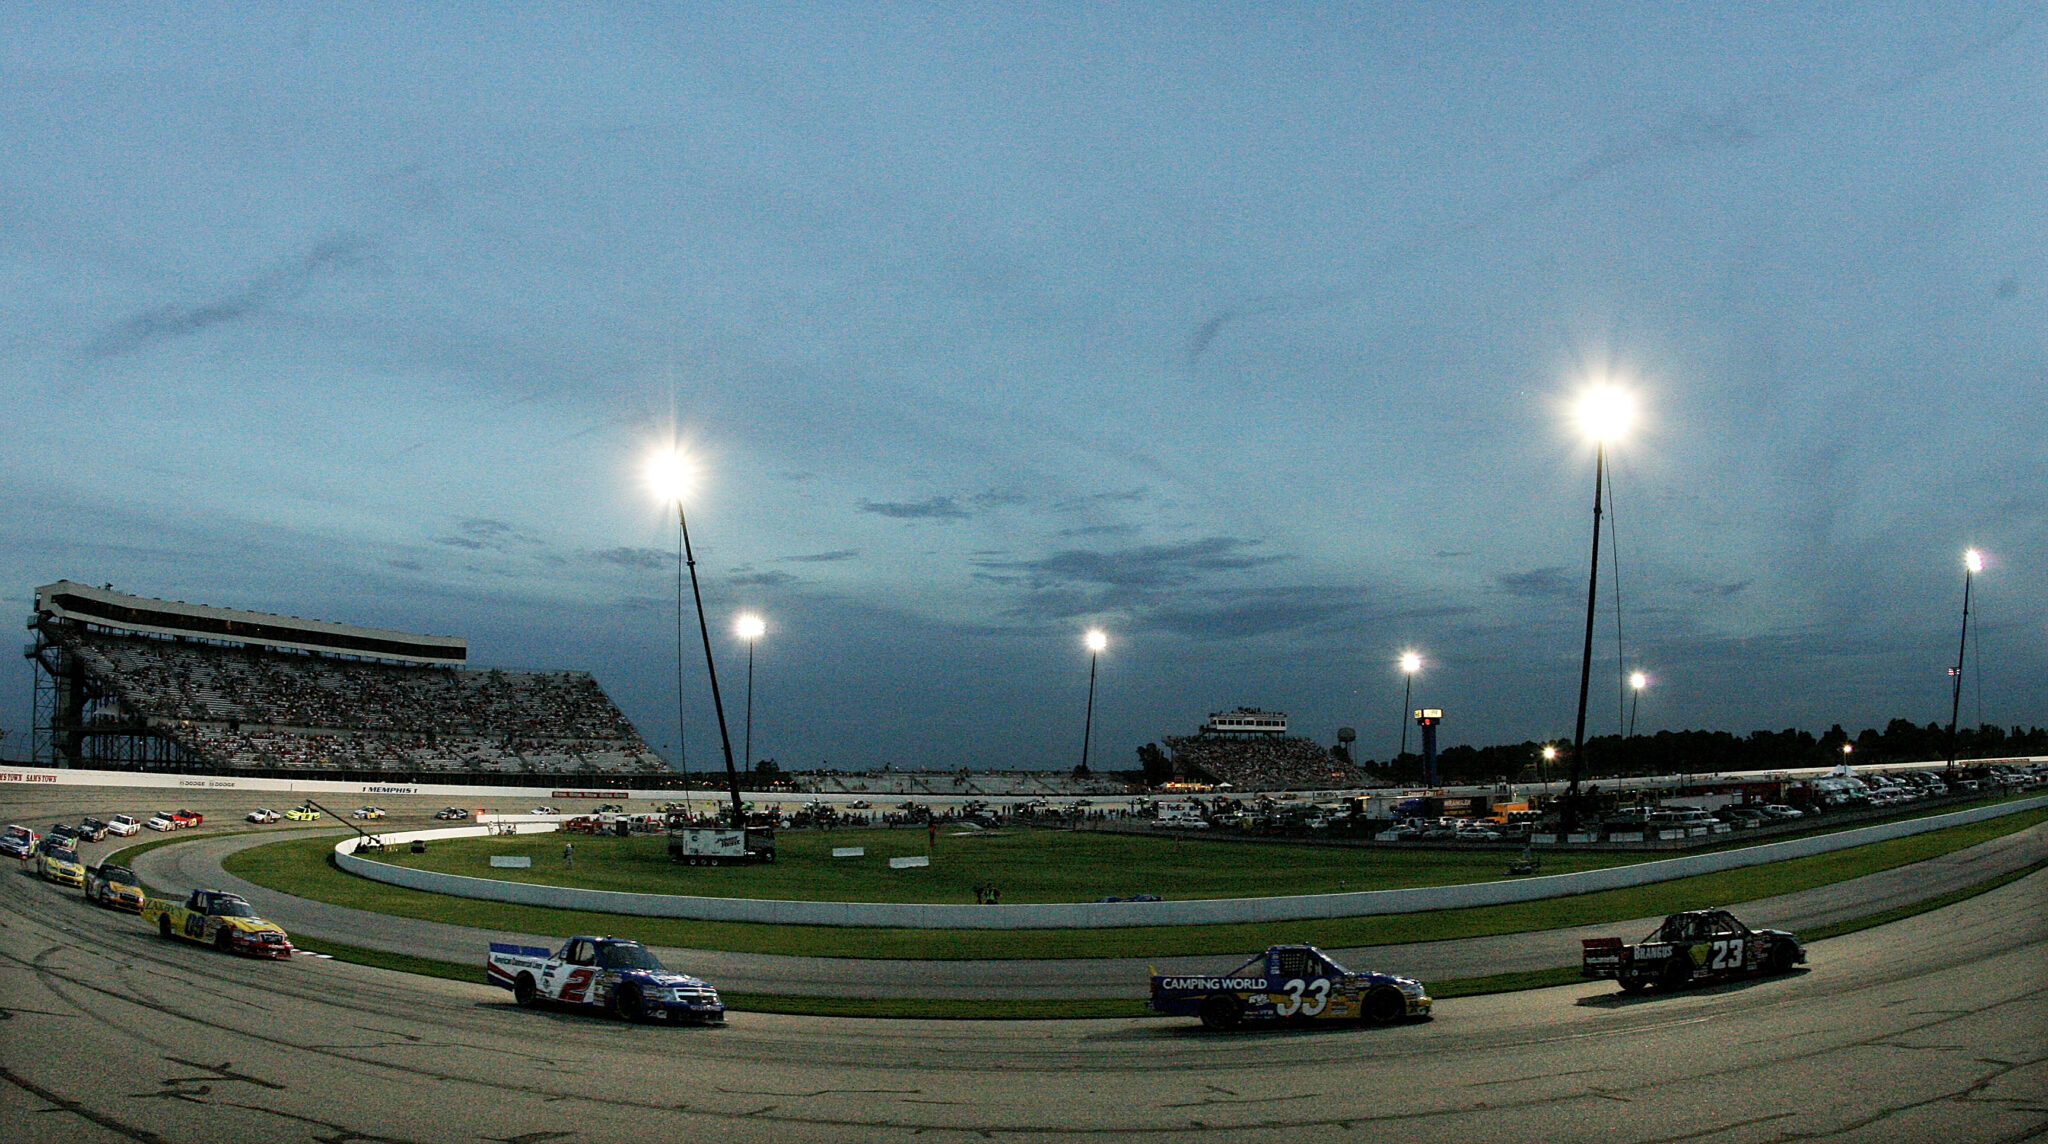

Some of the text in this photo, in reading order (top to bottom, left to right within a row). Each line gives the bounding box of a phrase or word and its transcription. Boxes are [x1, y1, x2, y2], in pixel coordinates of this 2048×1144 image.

[1633, 945, 1673, 960] BRANGUS
[1713, 939, 1743, 970] 23
[560, 969, 594, 1002] 2
[1162, 978, 1268, 990] CAMPING WORLD
[1276, 978, 1331, 1017] 33
